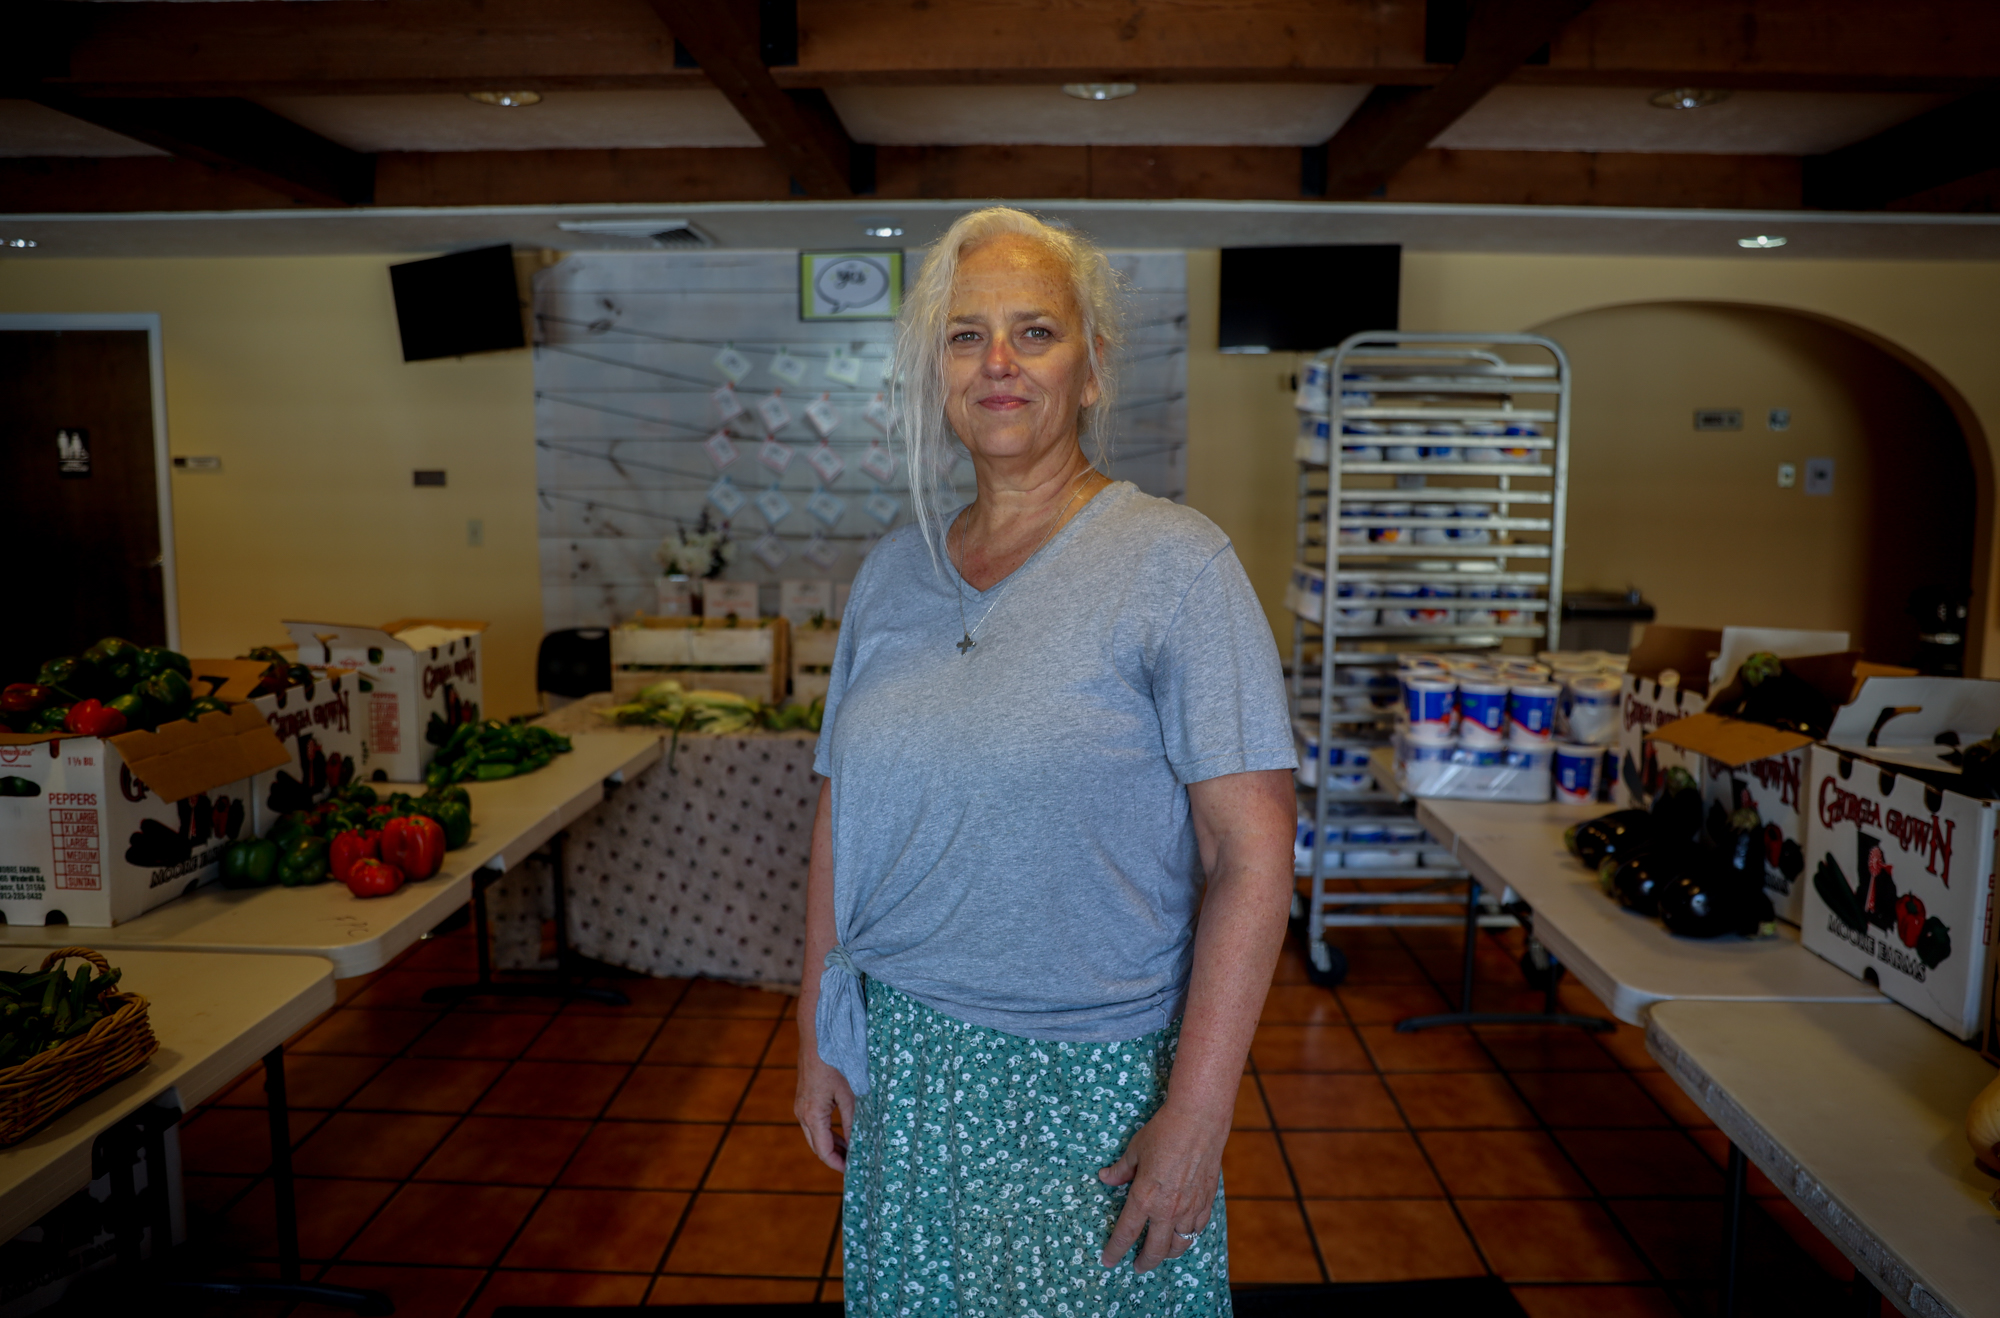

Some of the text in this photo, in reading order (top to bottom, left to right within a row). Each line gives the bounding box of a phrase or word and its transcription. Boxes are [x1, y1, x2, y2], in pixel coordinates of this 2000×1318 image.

[49, 793, 97, 805] PEPPERS
[63, 812, 96, 821] XX LARGE
[65, 825, 95, 834] X LARGE
[1819, 776, 1955, 890] GEORGIA GROWN
[66, 838, 89, 847] LARGE
[67, 851, 97, 860] MEDIUM
[67, 864, 92, 873] SELECT
[149, 855, 198, 889] MOORE
[69, 877, 97, 887] SUNTAN
[1827, 914, 1926, 983] MOORE FARMS
